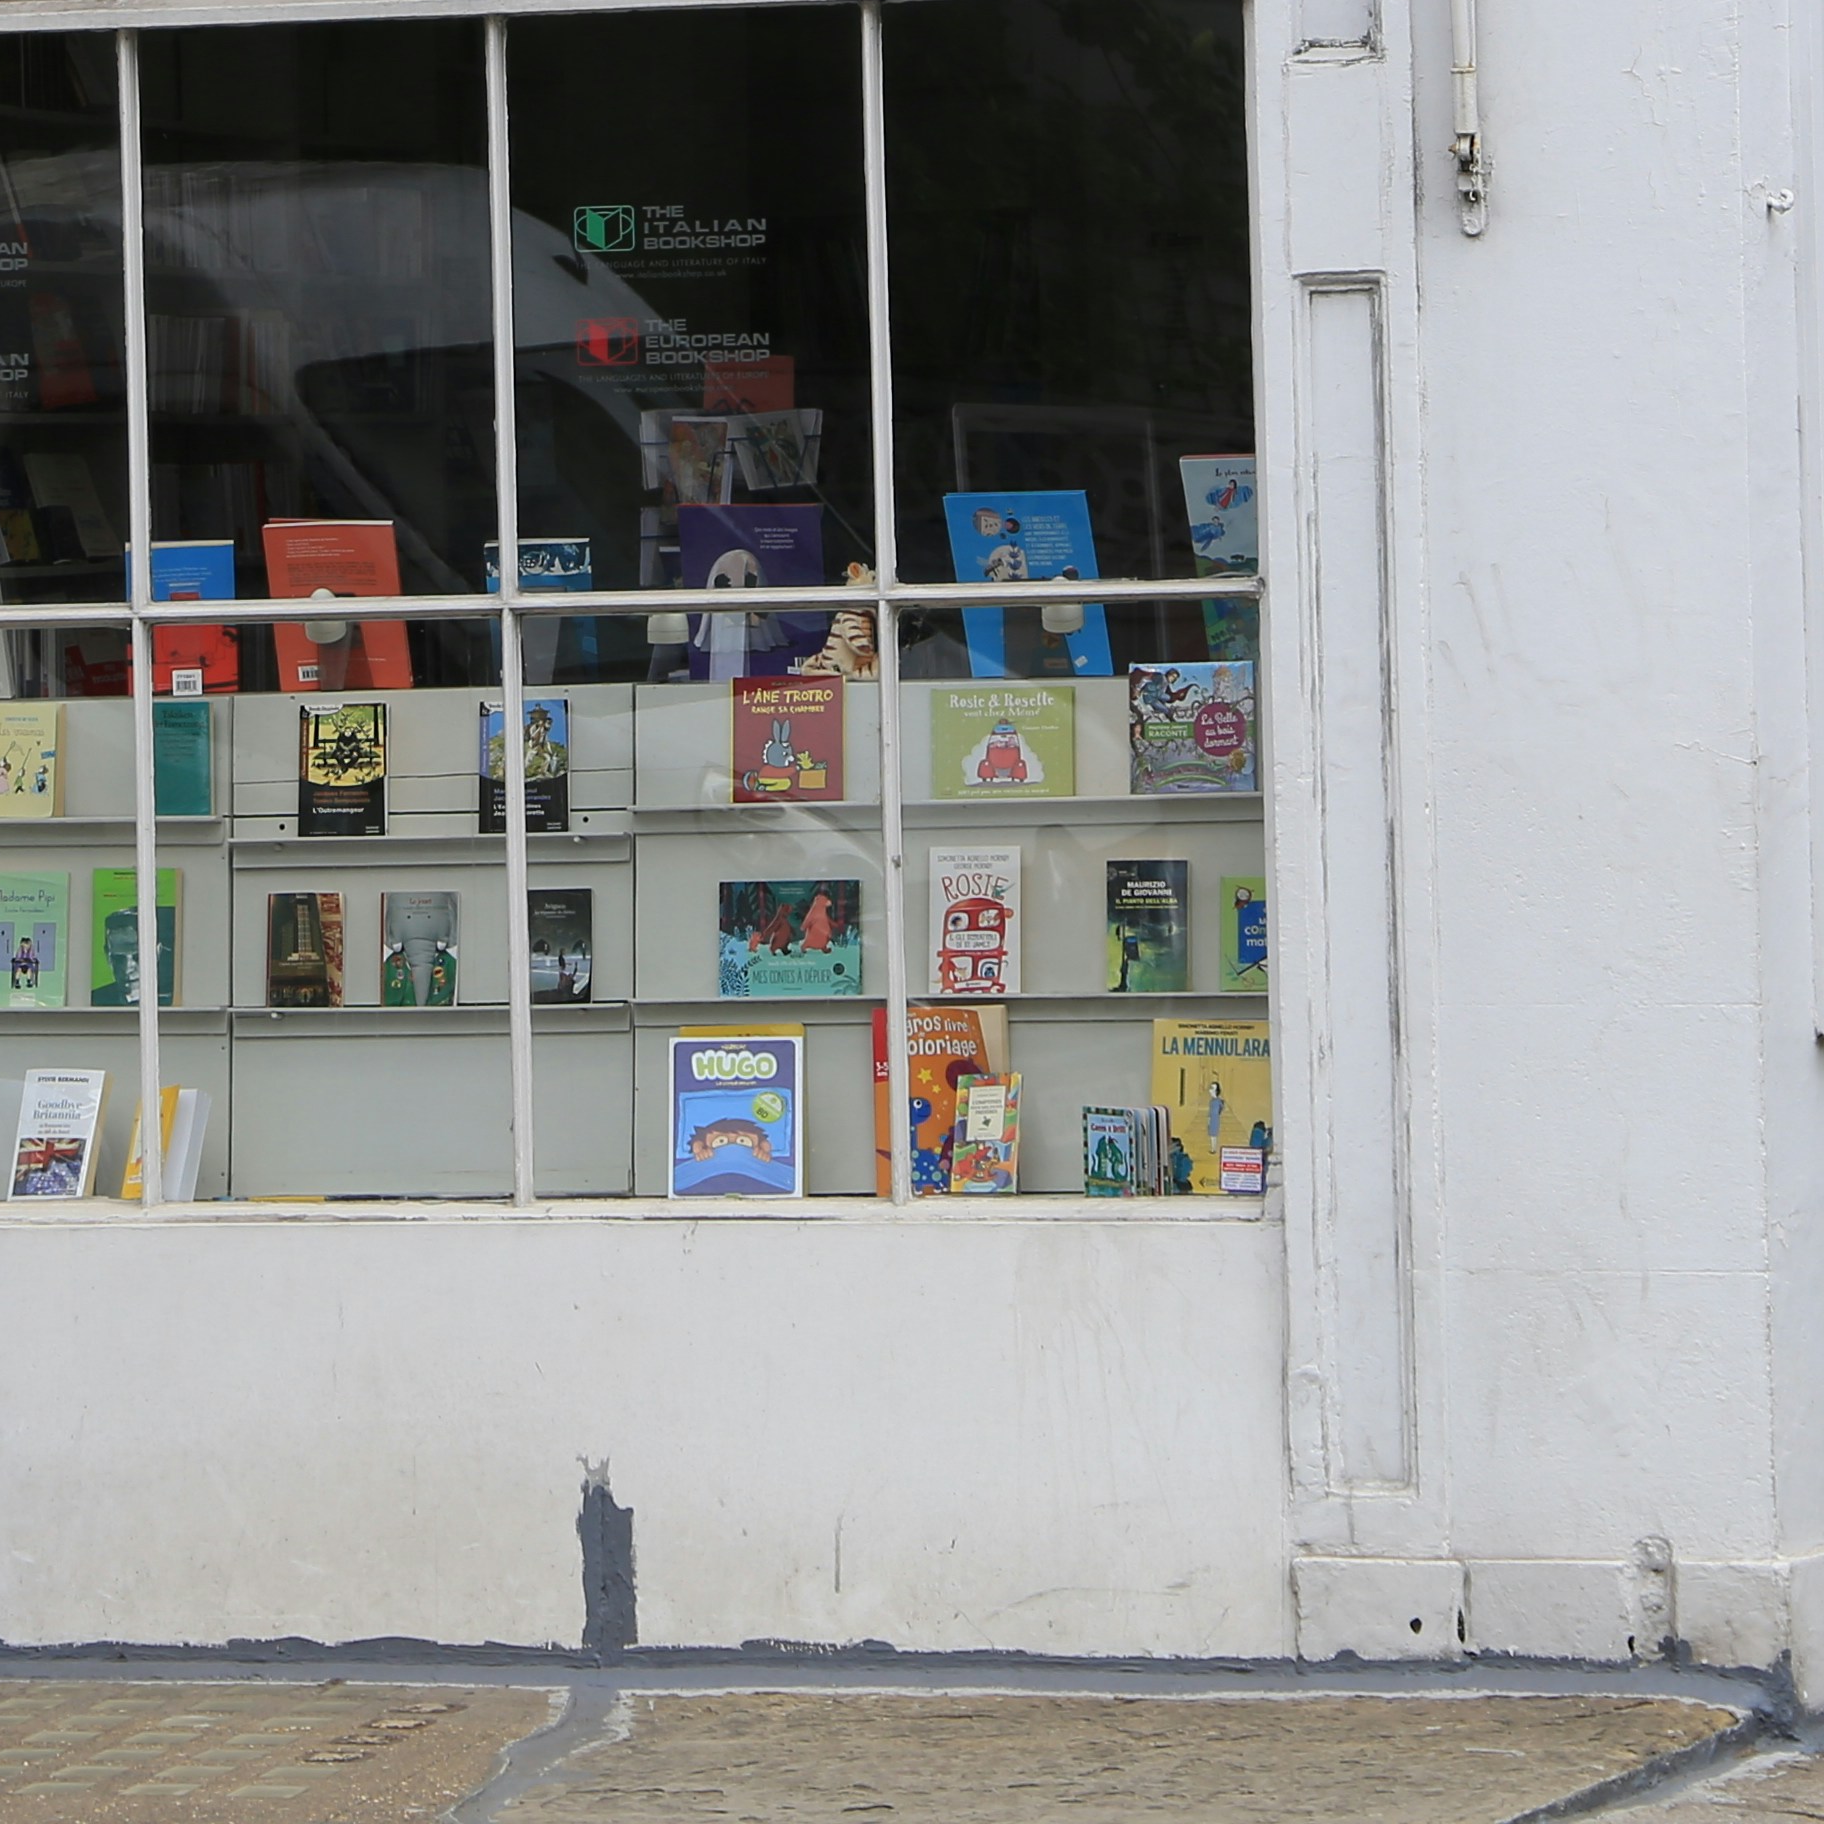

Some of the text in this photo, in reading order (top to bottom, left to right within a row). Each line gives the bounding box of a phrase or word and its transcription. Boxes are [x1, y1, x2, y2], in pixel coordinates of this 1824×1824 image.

[642, 206, 684, 218] THE
[643, 218, 766, 234] ITALIAN
[643, 234, 766, 250] BOOKSHOP
[645, 319, 687, 332] THE
[645, 333, 770, 349] EUROPEAN
[645, 350, 770, 365] BOOKSHOP
[783, 689, 834, 704] TROTRO
[949, 691, 1055, 709] Rosie & Rosette
[941, 873, 1010, 902] ROSIE
[1126, 880, 1166, 888] MAURIZIO
[38, 889, 55, 908] Pipi
[753, 970, 767, 984] MES
[944, 1018, 969, 1033] livre
[907, 1035, 978, 1057] oloriage
[1162, 1036, 1271, 1057] LA MENNULARA
[693, 1051, 777, 1080] HUGO
[33, 1109, 82, 1120] Britannia
